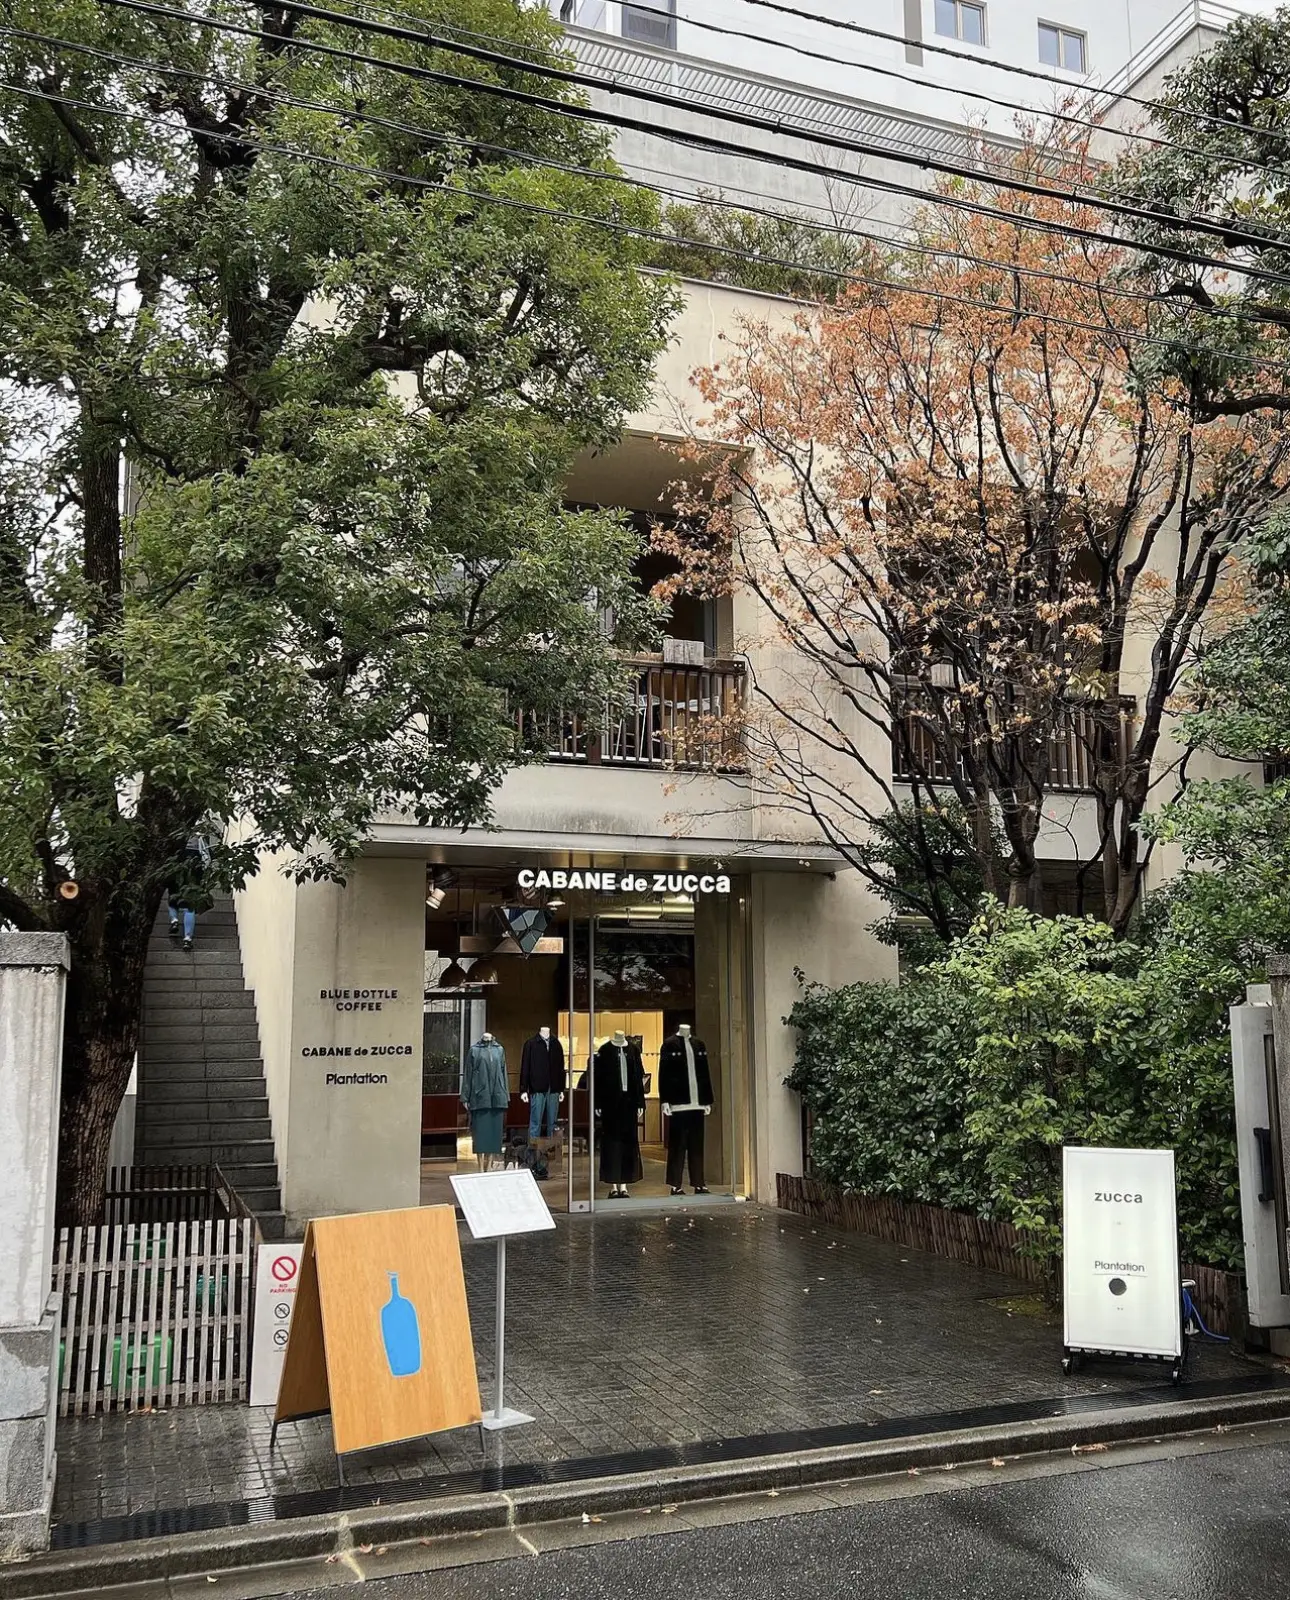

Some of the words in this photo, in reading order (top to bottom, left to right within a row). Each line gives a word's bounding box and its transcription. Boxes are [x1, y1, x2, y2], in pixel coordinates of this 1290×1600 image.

[517, 869, 617, 890] CABANE
[620, 876, 648, 892] de
[320, 989, 351, 999] BLUE
[353, 989, 398, 999] BOTTLE
[336, 1002, 382, 1011] COFFEE
[302, 1047, 352, 1057] CABANE
[354, 1046, 368, 1056] de
[326, 1073, 388, 1085] Plantation
[1094, 1260, 1145, 1272] Plantation
